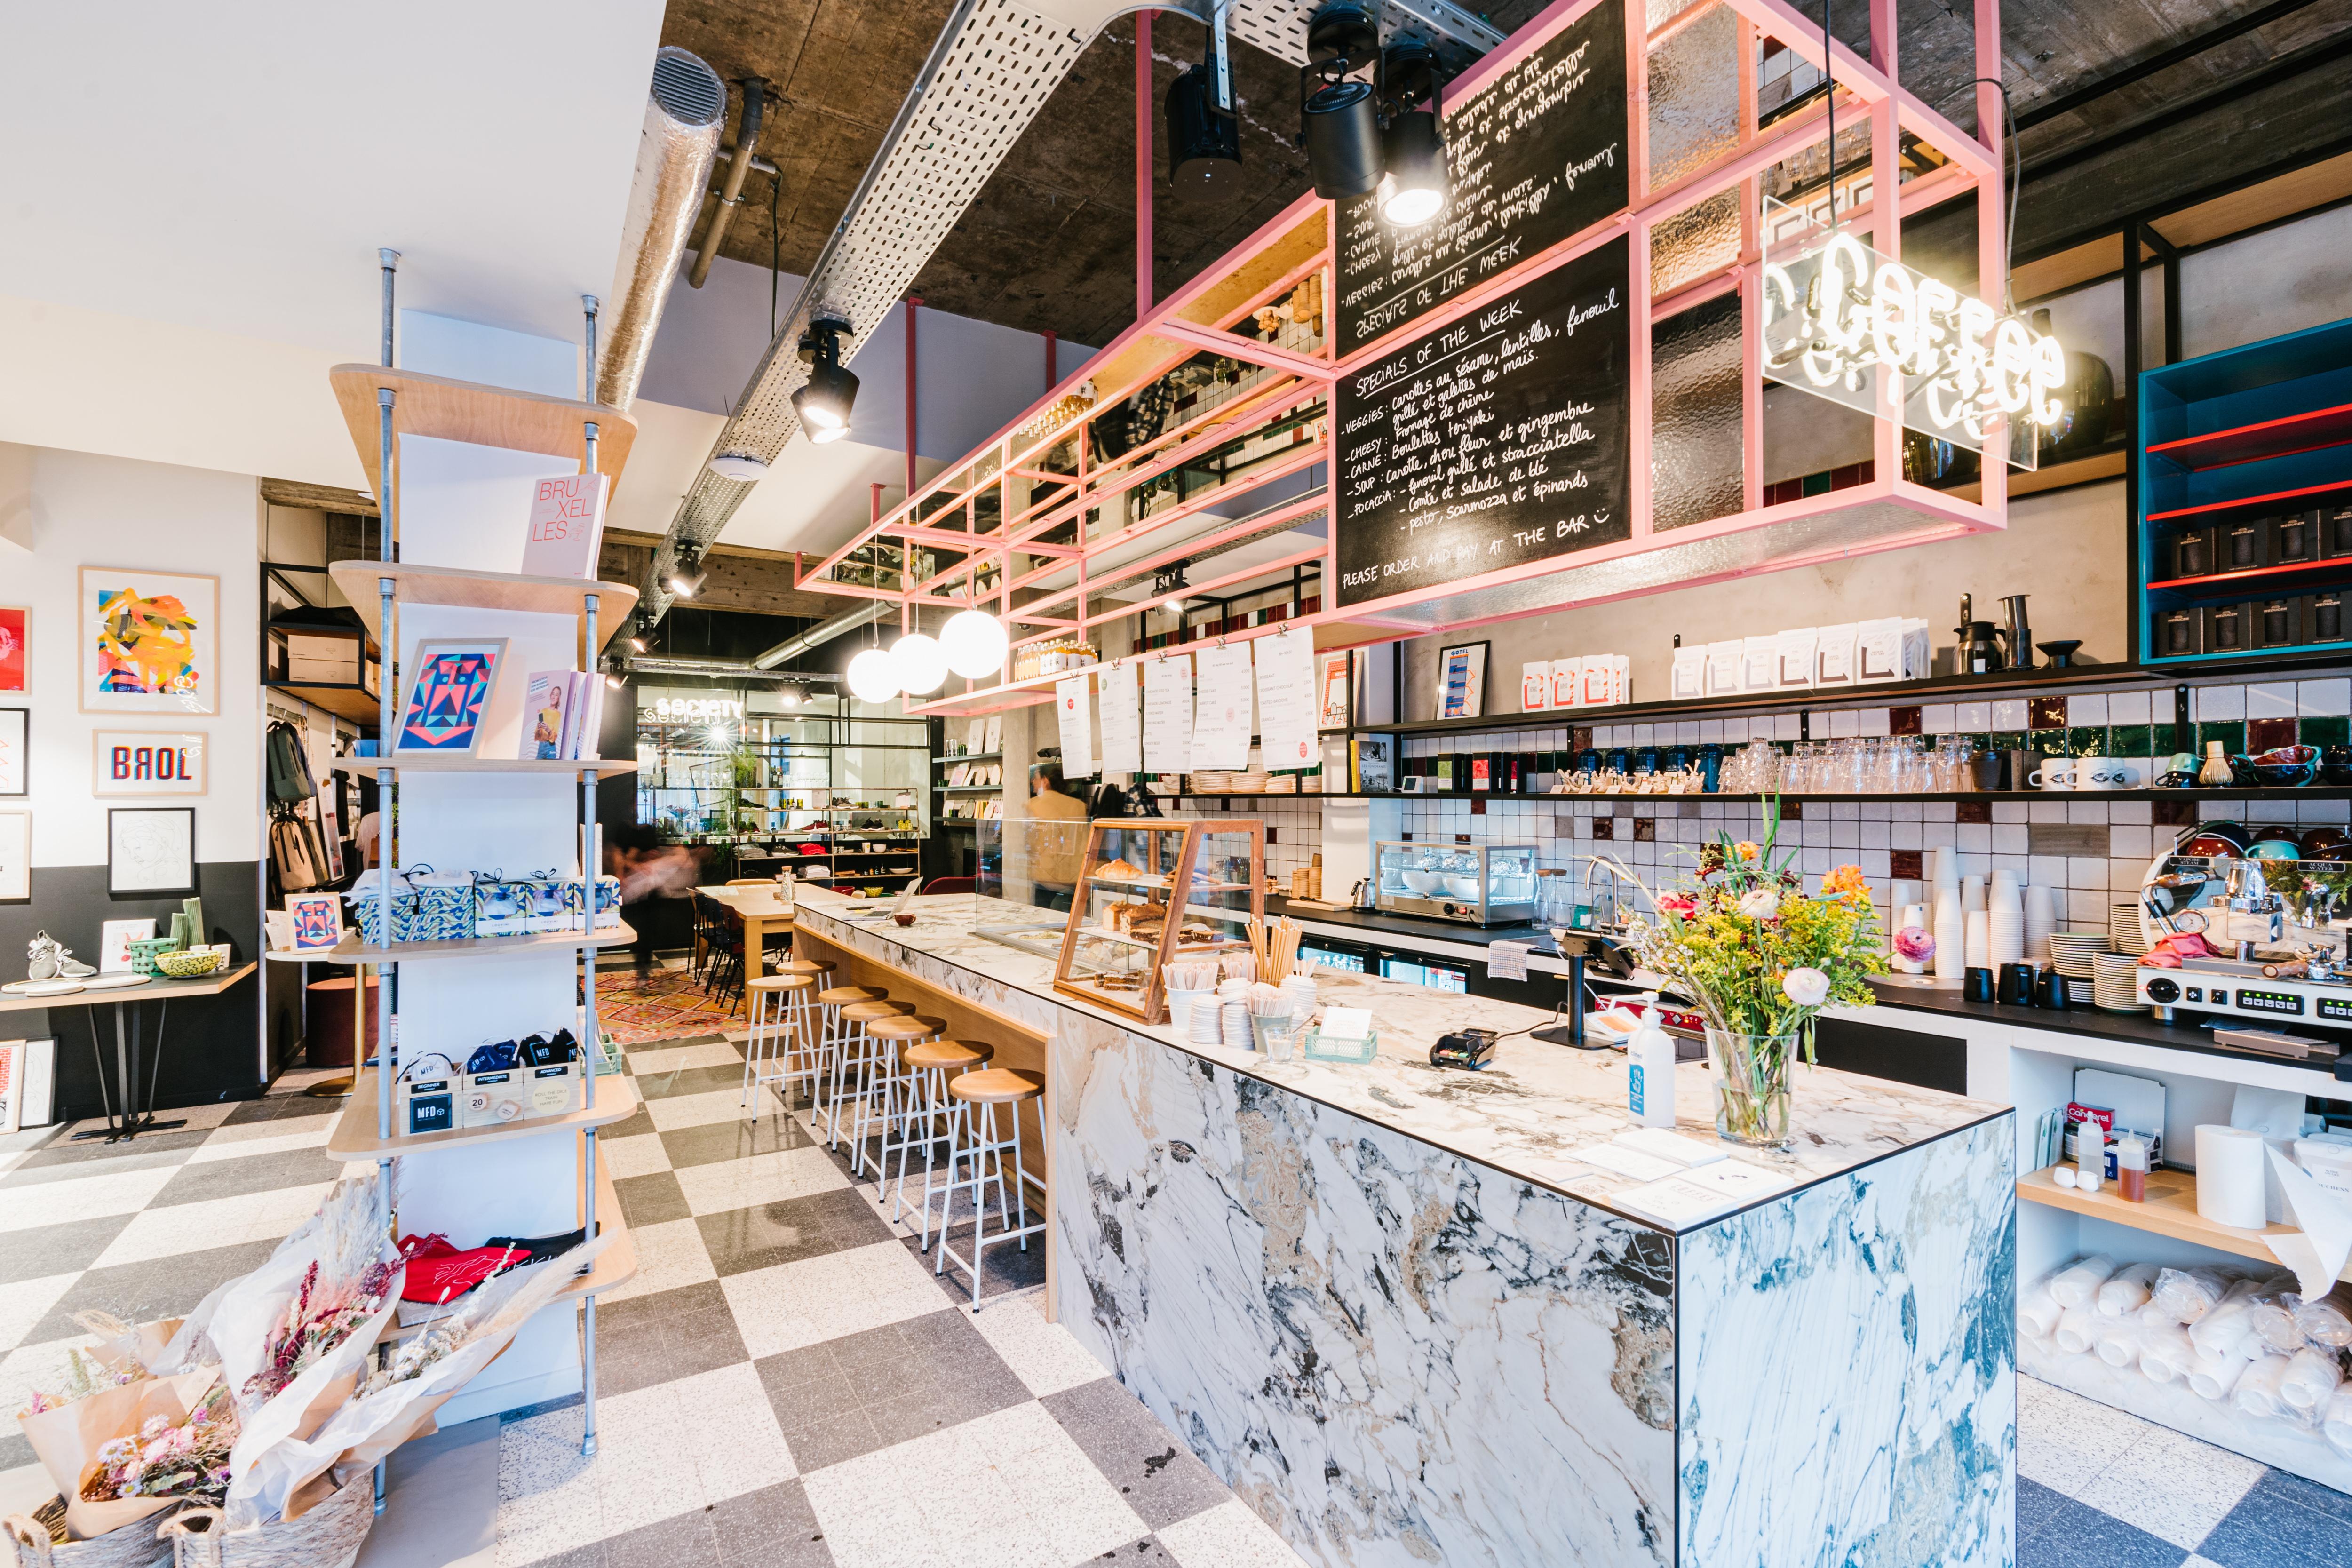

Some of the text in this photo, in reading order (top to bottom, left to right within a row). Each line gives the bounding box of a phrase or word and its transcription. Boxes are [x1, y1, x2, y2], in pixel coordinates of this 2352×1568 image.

[1417, 347, 1432, 364] OF
[1439, 326, 1469, 352] THE
[1480, 299, 1523, 333] WEEK
[1437, 374, 1452, 391] au
[1566, 289, 1619, 337] fenouil
[1392, 404, 1419, 430] grillé
[1423, 396, 1436, 411] et
[1438, 379, 1476, 408] galettes
[1482, 369, 1497, 384] de
[1440, 406, 1454, 421] de
[1457, 391, 1494, 414] chèvre
[1430, 446, 1456, 466] chou
[1499, 424, 1513, 440] et
[1518, 399, 1595, 442] gingembre
[1447, 458, 1477, 481] grillé
[1483, 452, 1495, 469] et
[1502, 423, 1595, 463] stracciatella
[539, 478, 580, 501] BRU
[1442, 484, 1453, 500] et
[1509, 466, 1525, 483] de
[1528, 454, 1549, 478] blé
[1513, 486, 1526, 502] et
[1534, 470, 1588, 502] épinards
[555, 498, 591, 519] XEL
[532, 520, 568, 541] LES
[1343, 565, 1378, 589] PLEASE
[1383, 556, 1420, 576] ORDER
[1427, 548, 1450, 565] AND
[1489, 539, 1504, 556] AT
[1514, 526, 1546, 548] THE
[1556, 514, 1590, 538] BAR
[536, 1048, 550, 1057] MFD
[420, 1065, 434, 1075] MFD
[417, 1106, 436, 1119] MFD
